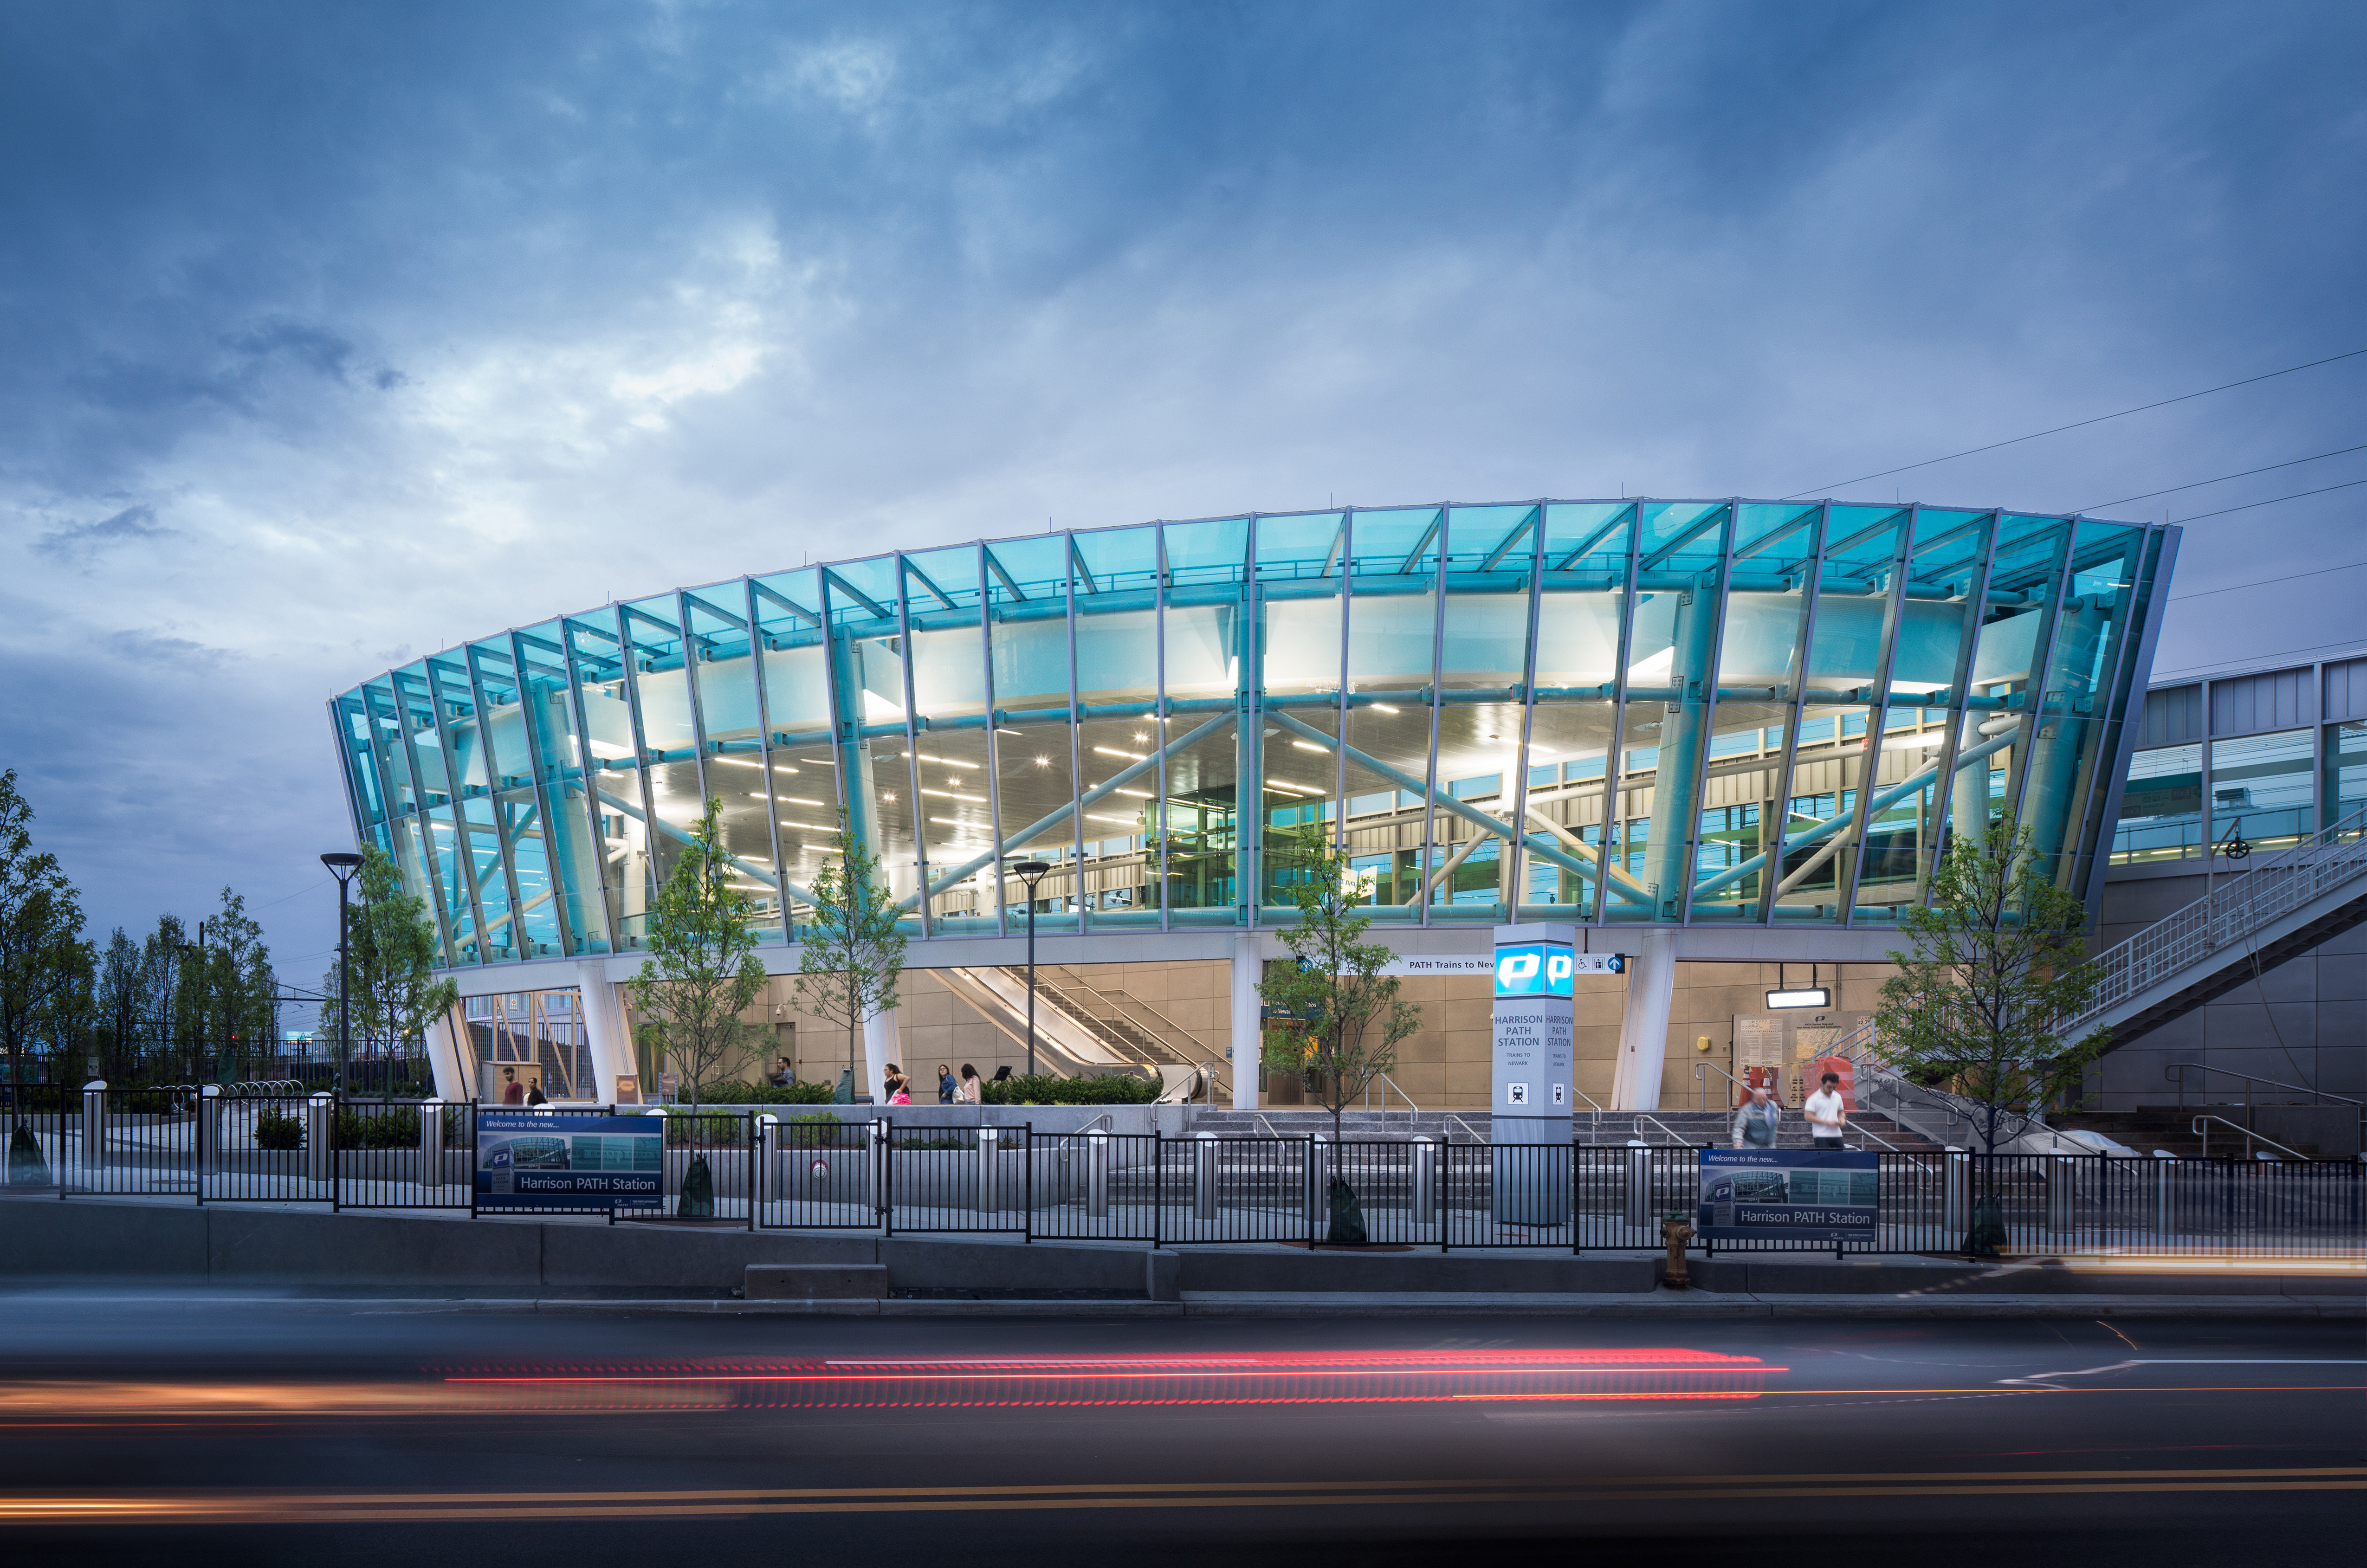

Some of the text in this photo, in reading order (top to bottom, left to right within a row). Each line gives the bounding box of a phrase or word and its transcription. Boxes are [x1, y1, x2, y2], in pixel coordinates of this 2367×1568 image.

[1495, 1015, 1543, 1024] HARRISON
[1546, 1015, 1573, 1025] HARRISON
[1506, 1026, 1531, 1035] PATH
[1552, 1026, 1566, 1035] PATH
[1498, 1038, 1539, 1046] STATION
[1548, 1038, 1571, 1046] STATION
[521, 1176, 572, 1189] Harrison
[577, 1177, 608, 1189] PATH
[613, 1177, 655, 1190] Station
[1741, 1210, 1870, 1224] Harrison PATH Station
